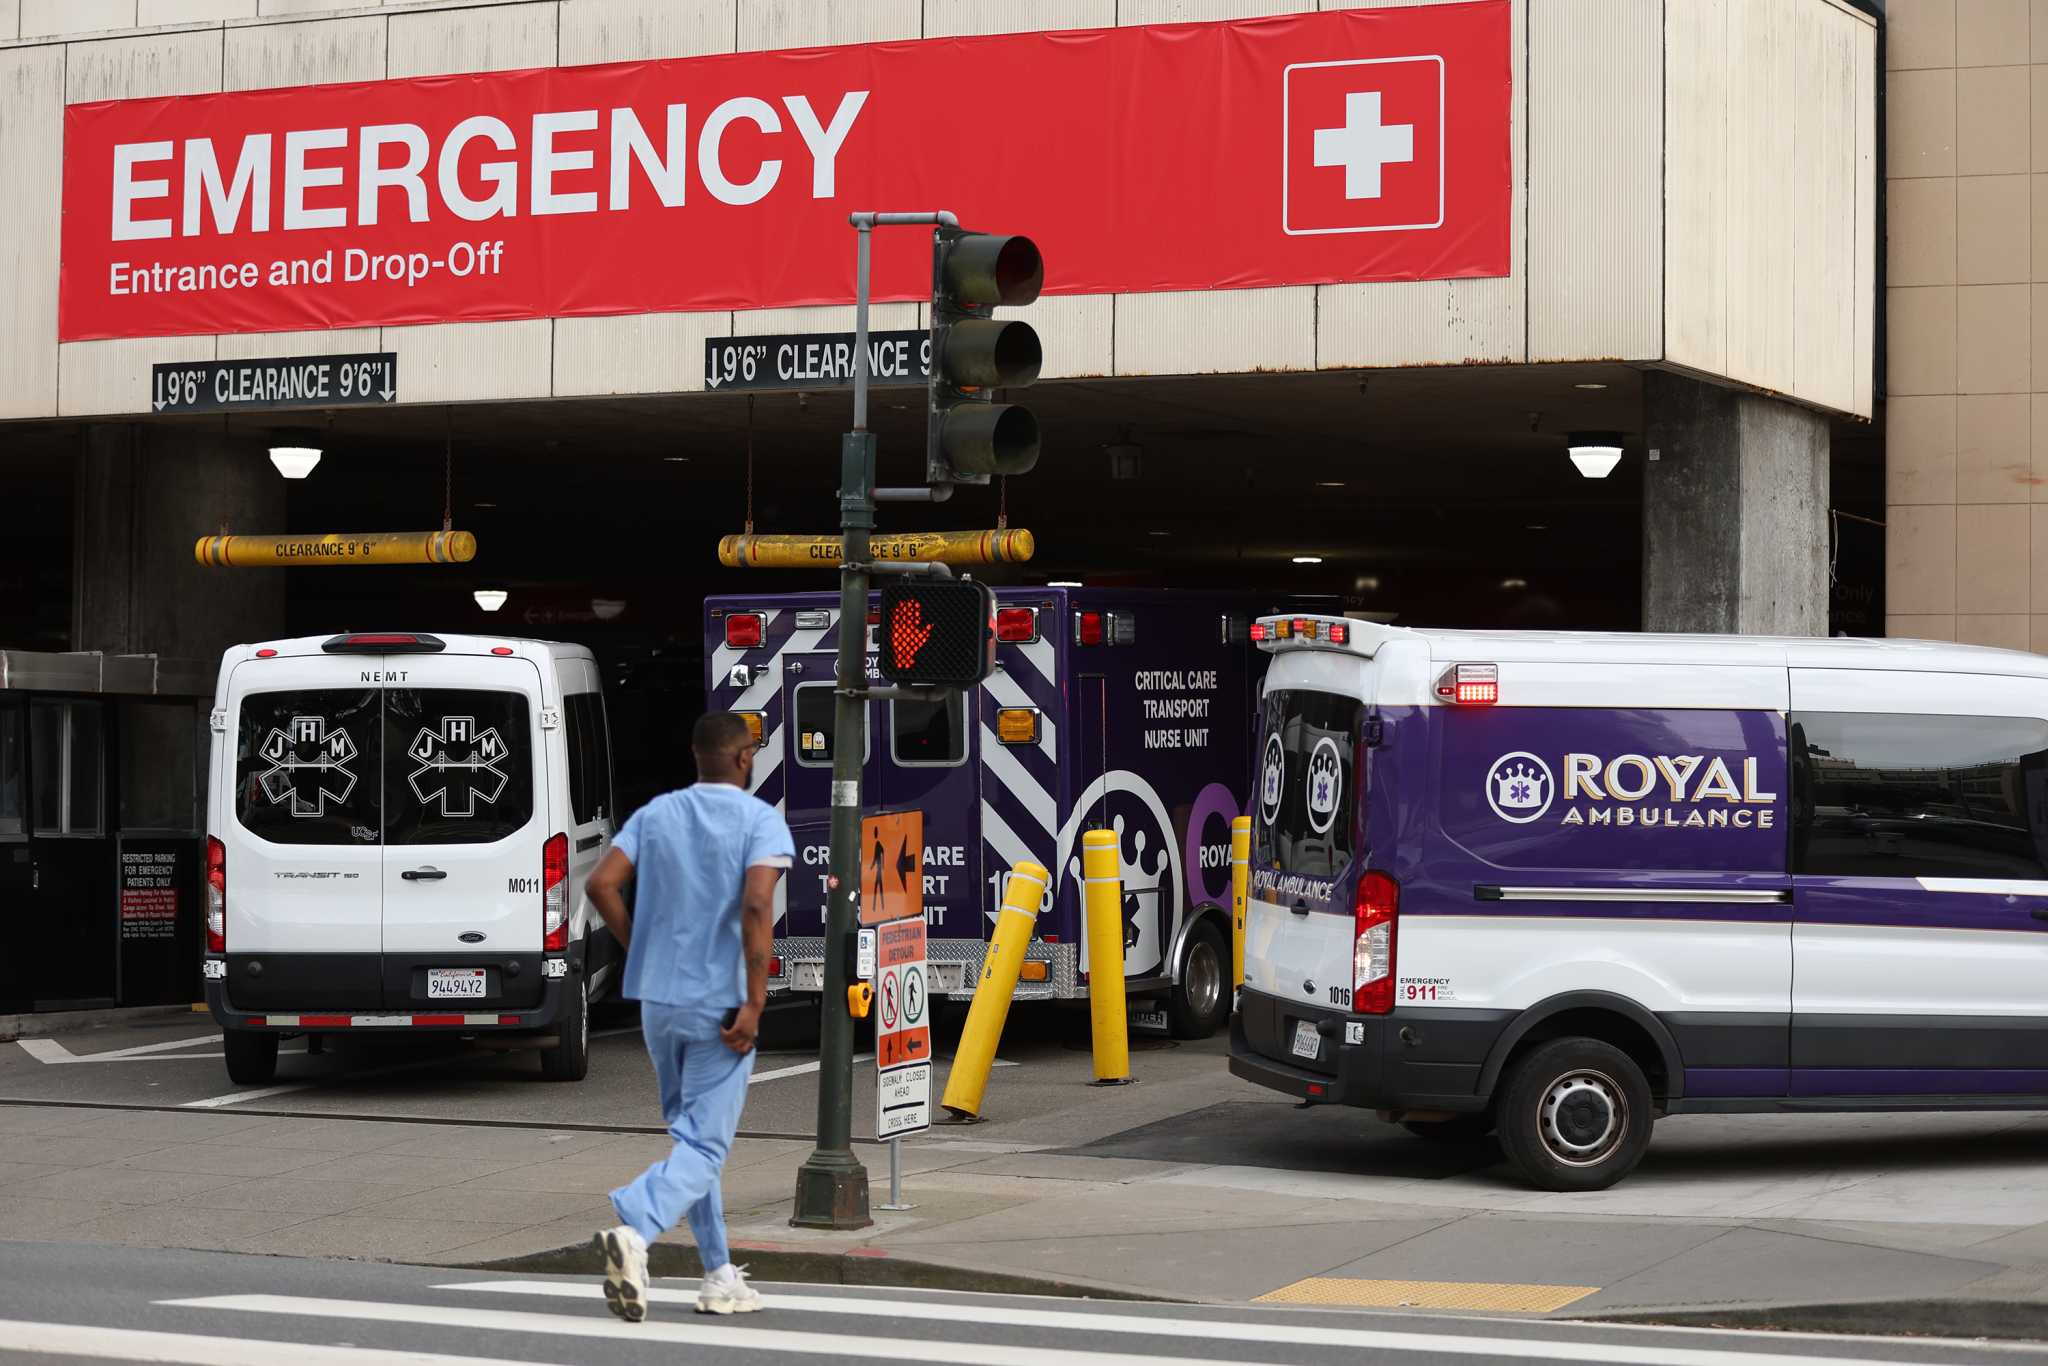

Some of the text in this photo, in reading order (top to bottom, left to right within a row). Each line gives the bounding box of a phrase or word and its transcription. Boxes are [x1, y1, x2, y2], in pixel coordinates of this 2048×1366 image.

[110, 90, 869, 242] EMERGENCY
[109, 241, 504, 296] Entrance and Drop-Off
[215, 364, 330, 402] CLEARANCE
[276, 543, 344, 557] CLEARANCE
[809, 543, 887, 560] CLEACE
[360, 671, 409, 683] NEMT
[1135, 671, 1217, 690] CRITICAL CARE
[1143, 699, 1209, 719] TRANSPORT
[1144, 728, 1209, 749] NURSE UNIT
[1563, 752, 1777, 803] ROYAL
[1561, 806, 1776, 828] AMBULANCE
[122, 853, 176, 863] RESTRICTED PARKING
[922, 846, 965, 866] ARE
[1199, 844, 1233, 869] ROYA
[124, 865, 173, 875] FOR EMERGENCY
[127, 877, 171, 887] PATIENTS ONLY
[508, 878, 540, 894] M011
[1253, 870, 1334, 901] ROYAL AMBULANCE
[881, 928, 922, 945] PEDESTRIAN
[888, 945, 914, 962] DETOUR
[432, 980, 482, 993] 94494Y2
[1400, 977, 1450, 985] EMERGENCY
[1328, 986, 1350, 1006] 1016
[1407, 985, 1437, 1000] 911
[882, 1070, 926, 1088] SIDEWALK CLOSED
[894, 1086, 910, 1097] AHEAD
[887, 1113, 919, 1129] CROSS HERE
